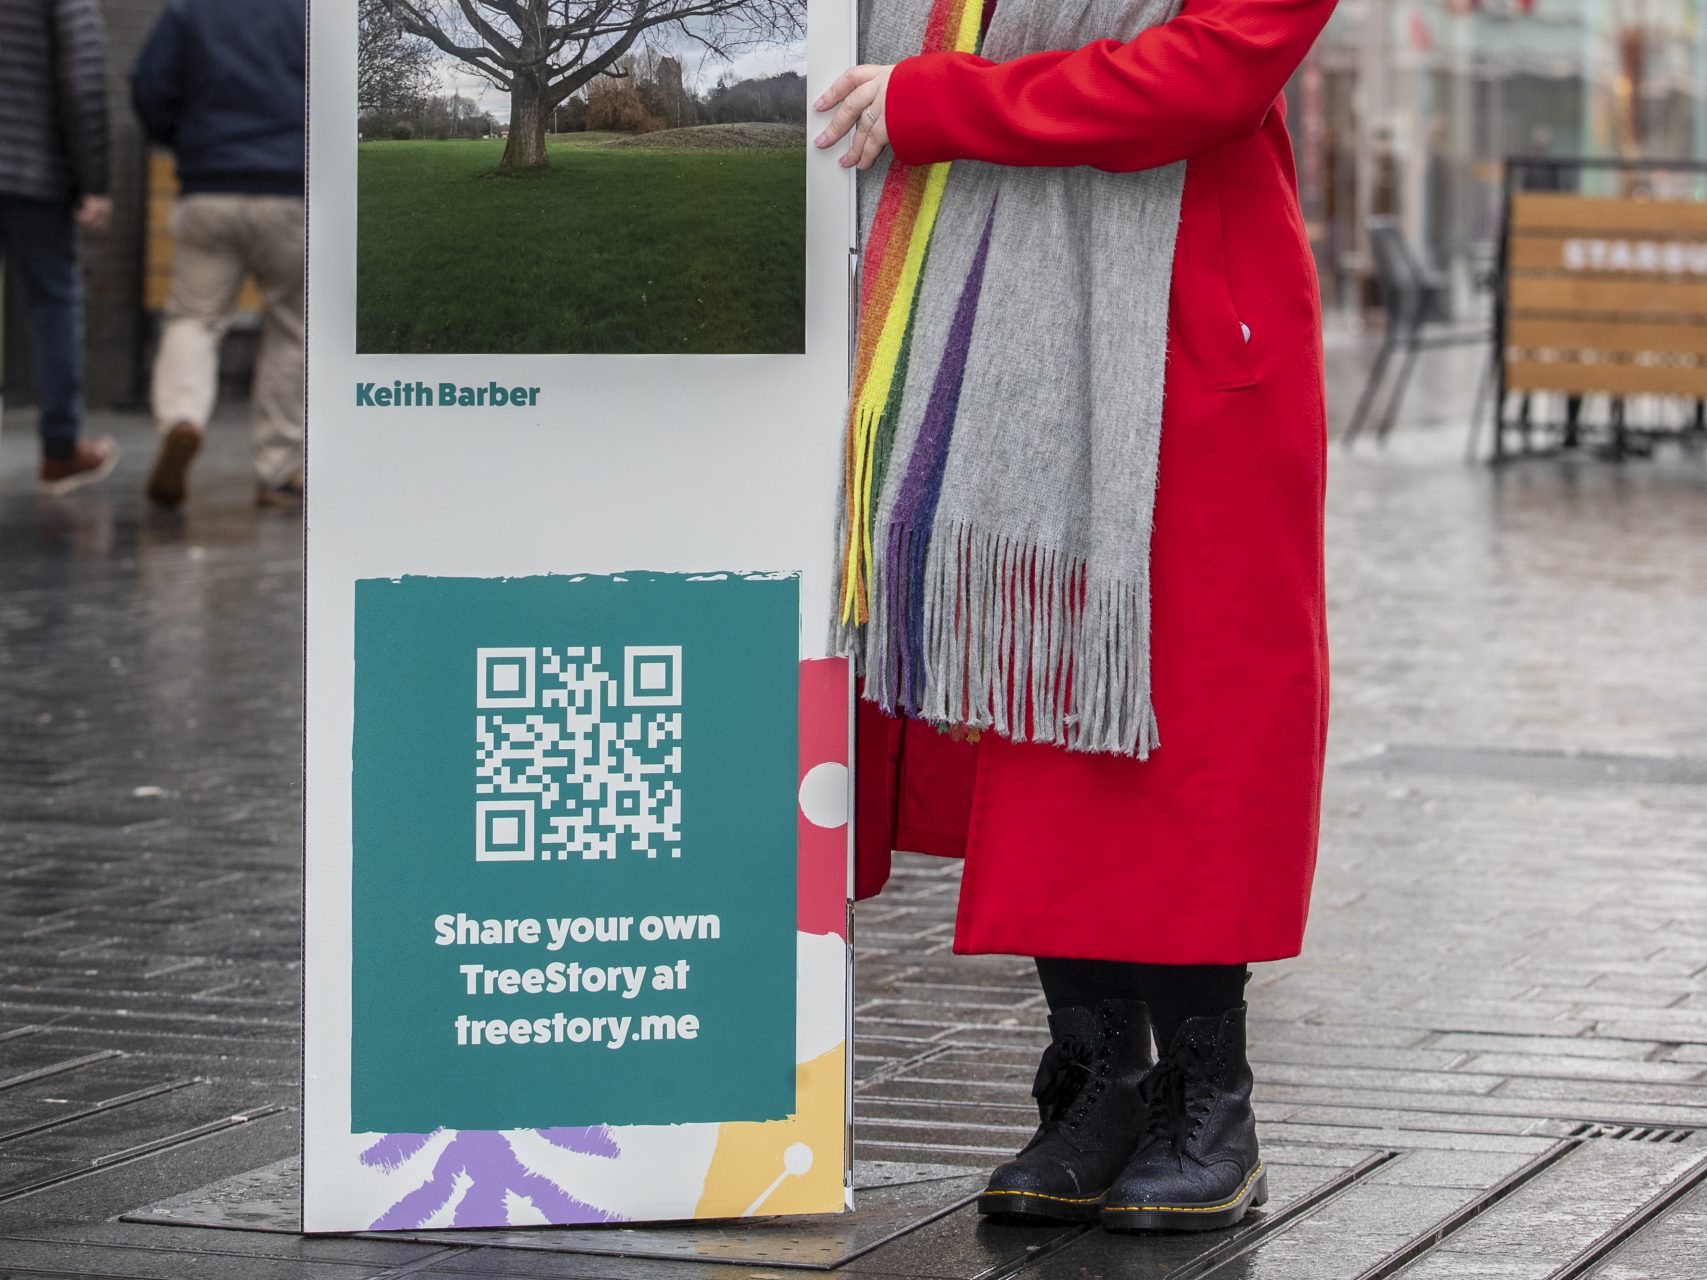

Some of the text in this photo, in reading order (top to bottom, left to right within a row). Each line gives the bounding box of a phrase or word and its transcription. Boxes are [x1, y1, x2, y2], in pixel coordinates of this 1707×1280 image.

[356, 380, 541, 407] Keith Barber
[434, 912, 721, 951] Share your own
[459, 959, 691, 1000] TreeStory at
[454, 1012, 700, 1050] treestory.me
